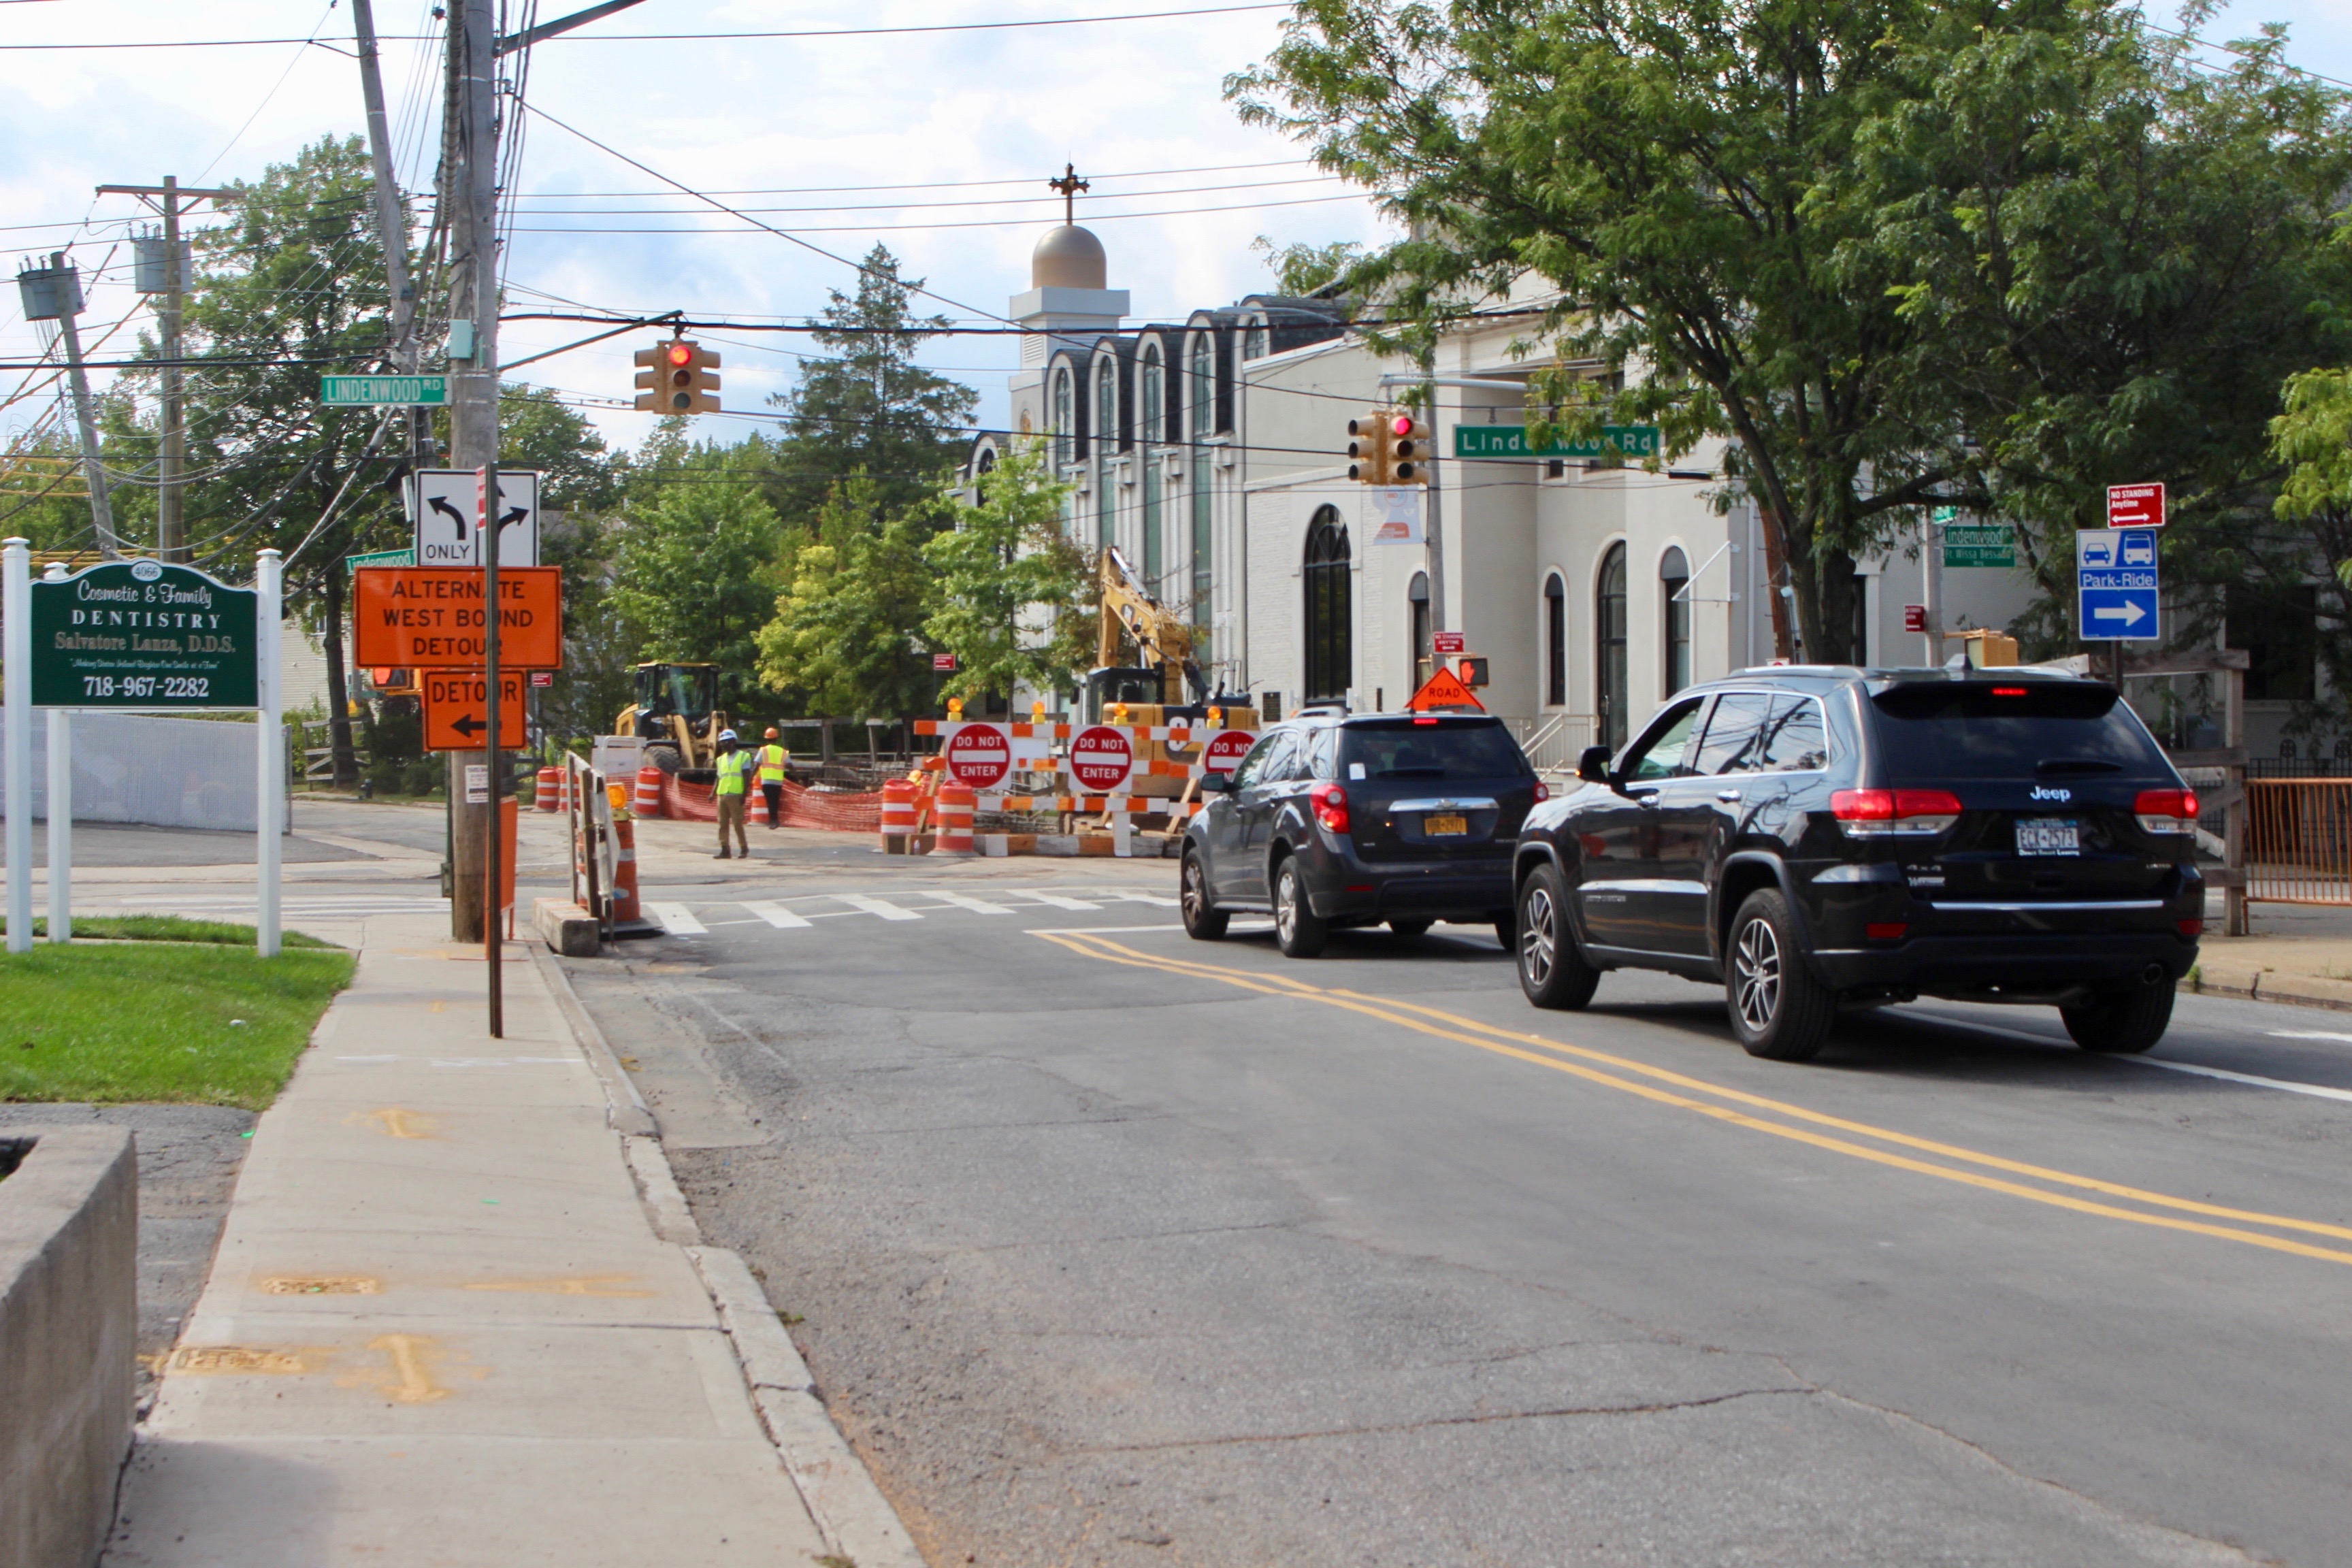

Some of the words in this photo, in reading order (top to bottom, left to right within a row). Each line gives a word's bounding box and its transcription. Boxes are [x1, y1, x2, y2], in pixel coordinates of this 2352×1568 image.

[327, 379, 421, 402] LINDENWOOD
[423, 379, 441, 391] RD
[1623, 433, 1651, 451] Rd
[2111, 491, 2121, 499] NO
[2122, 489, 2155, 497] STANDING
[2111, 500, 2139, 510] Anytime
[426, 544, 470, 559] ONLY
[135, 566, 159, 578] 4066
[2082, 573, 2153, 587] Park-Ride
[78, 579, 139, 602] Cosmetic
[144, 585, 157, 603] &
[159, 583, 212, 610] Family
[391, 581, 525, 599] ALTERNTE
[71, 609, 220, 629] DENTISTRY
[383, 609, 444, 627] WEST
[456, 609, 534, 627] BOND
[55, 632, 127, 651] Salvatore
[131, 634, 183, 655] Lanza,
[188, 635, 236, 653] D.D.S.
[413, 637, 502, 656] DETOU
[84, 676, 210, 698] 718-967-2282
[433, 681, 517, 702] DETOR
[1429, 687, 1460, 698] ROAD
[956, 736, 973, 747] DO
[978, 736, 1002, 747] NOT
[1079, 738, 1096, 749] DO
[1101, 739, 1124, 750] NOT
[1213, 742, 1229, 753] DO
[960, 766, 998, 776] ENTER
[1082, 767, 1120, 779] ENTER
[2030, 785, 2071, 802] Jeep
